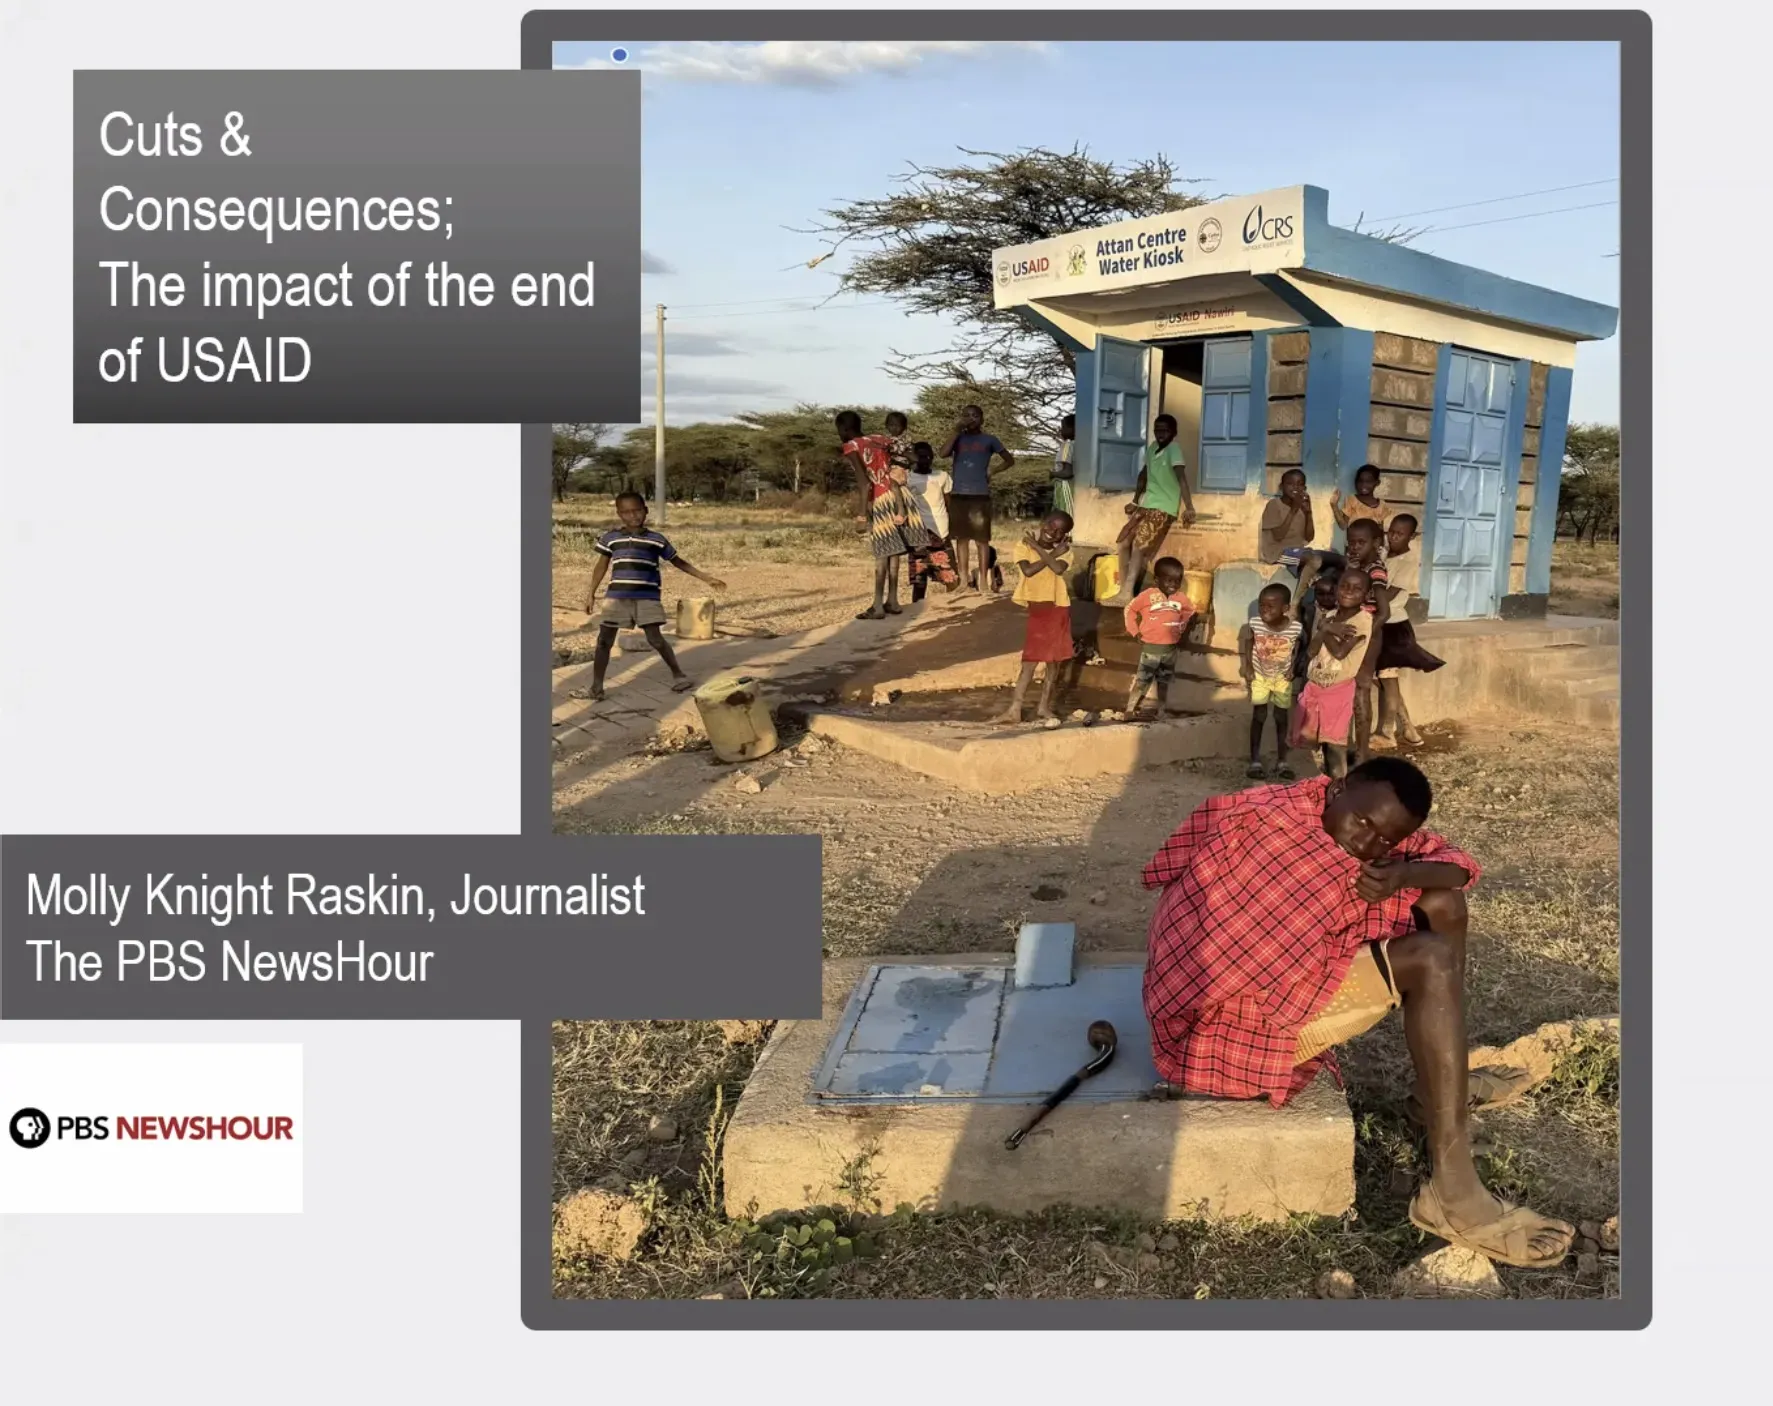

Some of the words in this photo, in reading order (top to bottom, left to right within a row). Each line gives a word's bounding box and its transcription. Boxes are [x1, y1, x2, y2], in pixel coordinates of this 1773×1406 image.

[1261, 215, 1294, 241] CRS
[1096, 237, 1134, 257] Attan
[1138, 228, 1187, 249] Centre
[1012, 256, 1050, 277] USAID
[1099, 256, 1140, 276] Water
[1143, 245, 1184, 269] Kiosk
[1168, 310, 1201, 324] USAID
